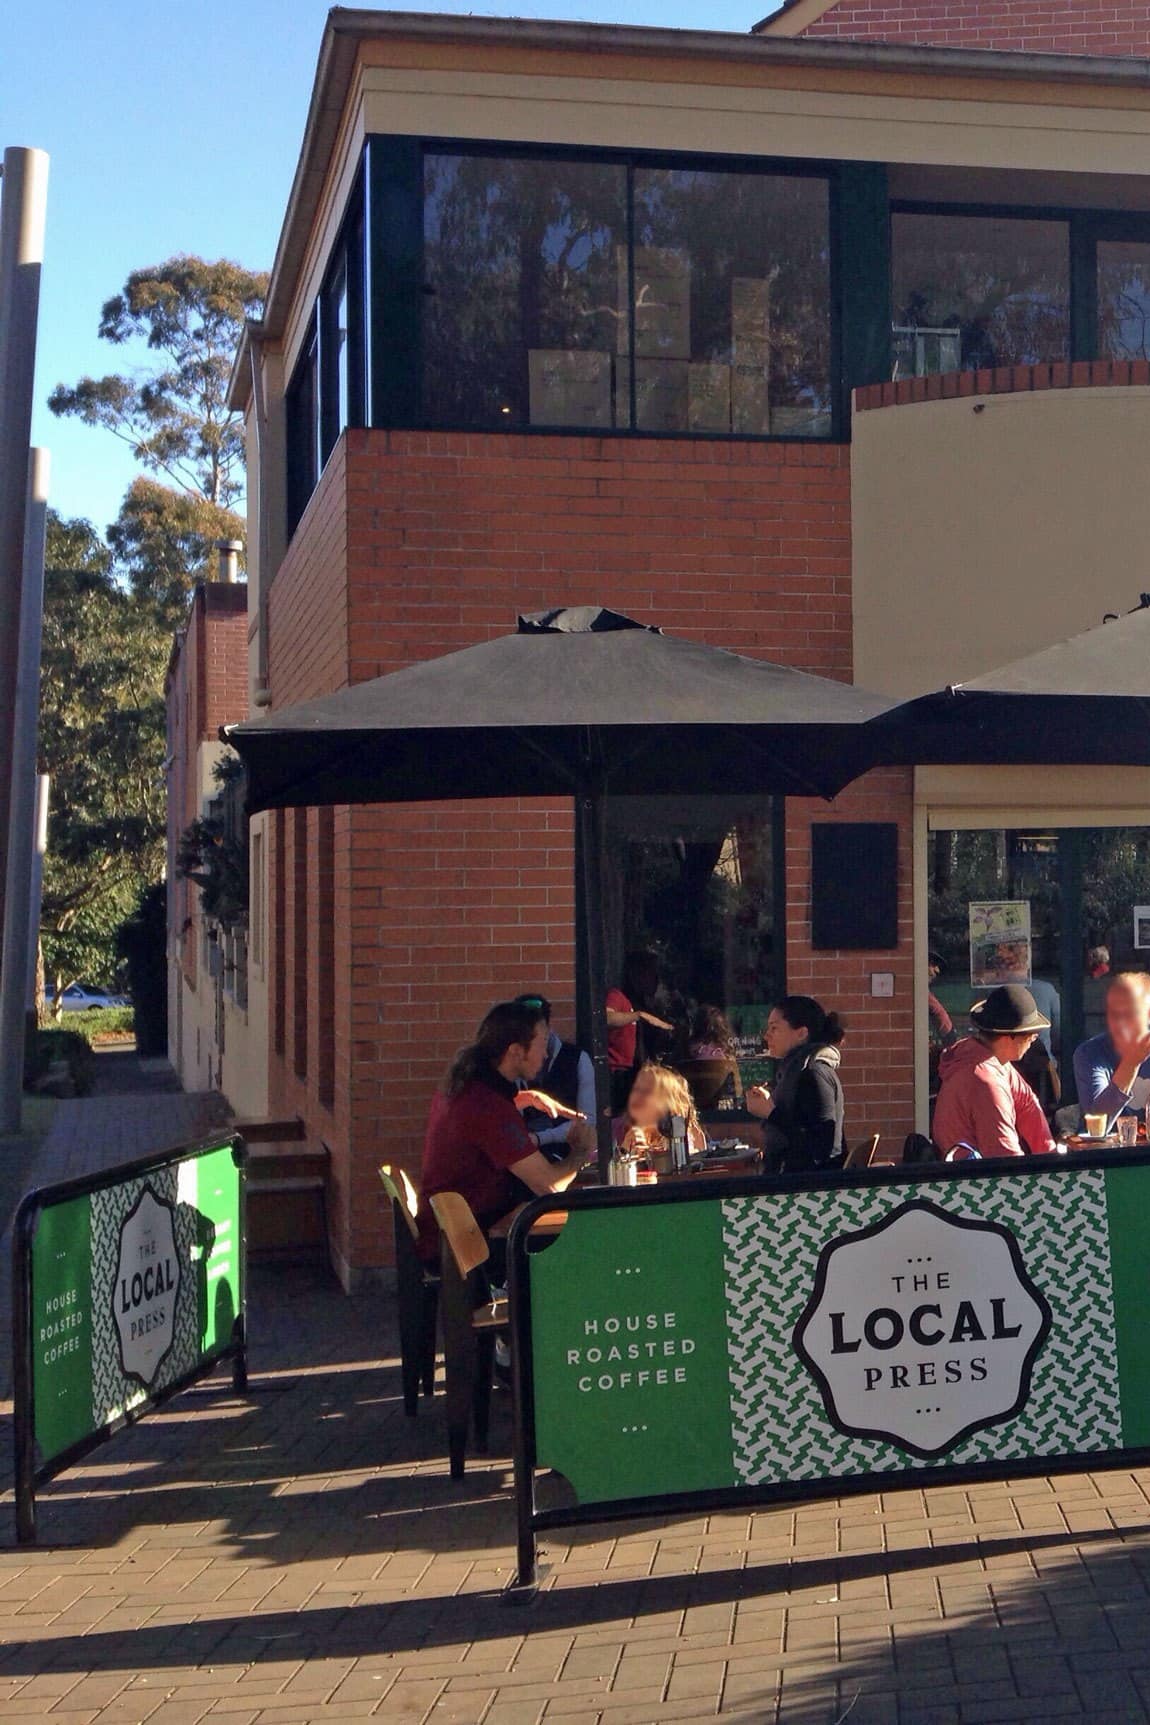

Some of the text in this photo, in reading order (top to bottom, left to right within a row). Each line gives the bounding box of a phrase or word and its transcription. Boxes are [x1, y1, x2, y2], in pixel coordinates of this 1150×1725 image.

[139, 1240, 156, 1259] THE
[121, 1259, 174, 1313] LOCAL
[891, 1272, 951, 1293] THE
[46, 1289, 78, 1314] HOUSE
[40, 1312, 82, 1342] ROASTED
[131, 1306, 165, 1341] PRESS
[584, 1312, 676, 1336] HOUSE
[828, 1298, 1023, 1354] LOCAL
[43, 1336, 80, 1365] COFFEE
[567, 1339, 696, 1365] ROASTED
[578, 1367, 687, 1392] COFFEE
[864, 1357, 988, 1391] PRESS
